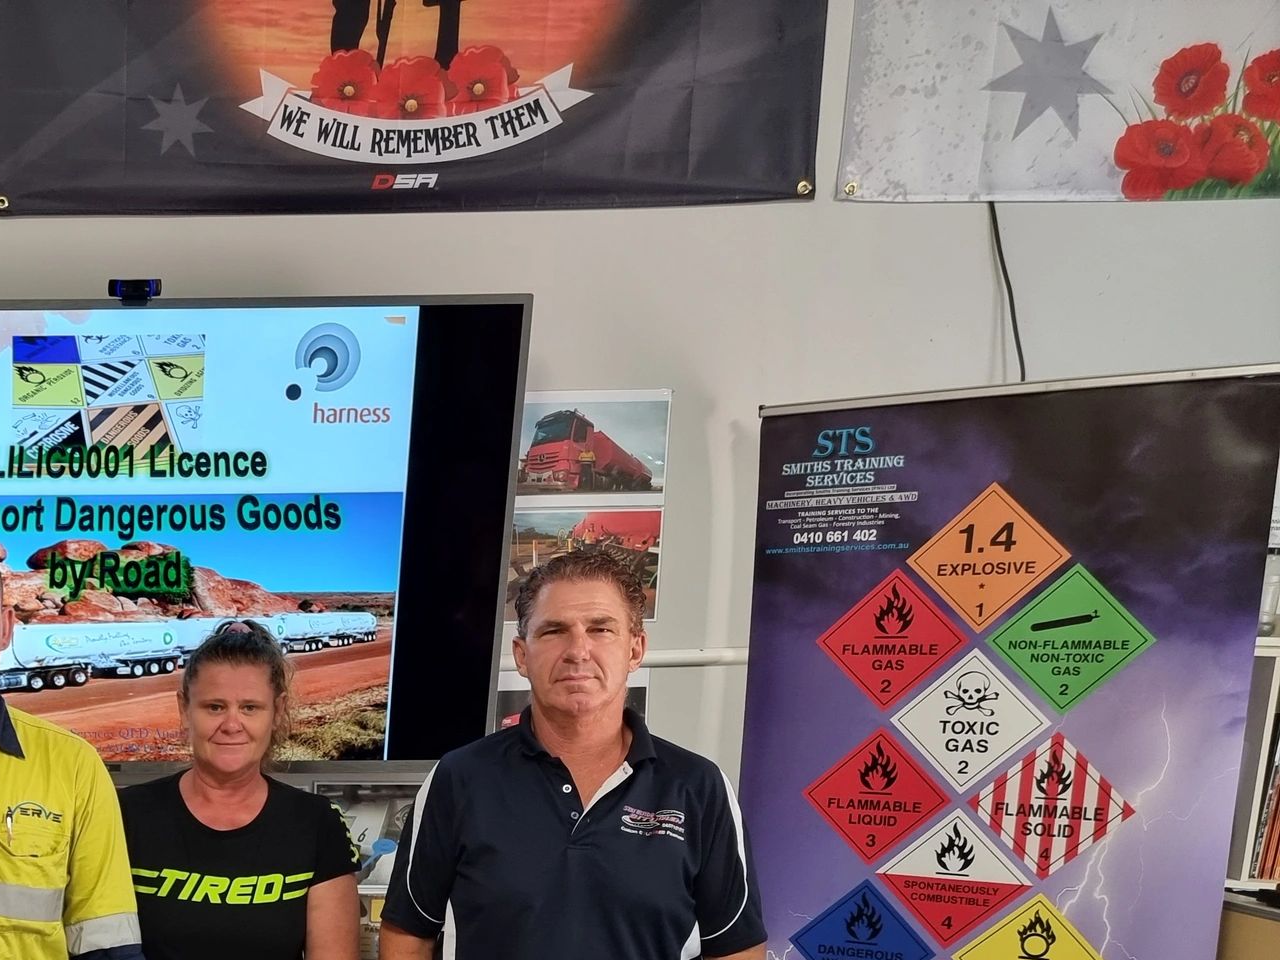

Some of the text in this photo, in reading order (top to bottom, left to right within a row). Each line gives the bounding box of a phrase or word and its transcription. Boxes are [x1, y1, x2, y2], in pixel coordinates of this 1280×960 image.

[280, 97, 549, 157] WE WILL REMEMBER THEM
[371, 173, 439, 190] DSA
[312, 403, 391, 424] harness
[101, 410, 138, 445] DANGEROUS
[813, 427, 873, 457] STS
[150, 445, 267, 479] Licence
[782, 456, 904, 475] SMITHS TRAINING
[806, 472, 874, 487] SERVICES
[55, 497, 226, 540] Dangerous
[237, 494, 341, 531] Goods
[793, 530, 876, 543] 0410 661 402
[958, 522, 1016, 554] 1.4
[766, 542, 909, 554] www.smithstrainingservices.com.au
[48, 552, 184, 598] by Road
[937, 561, 1036, 576] EXPLOSIVE
[842, 644, 938, 655] FLAMMABLE
[1008, 639, 1130, 651] NON-FLAMMABLE
[872, 659, 904, 671] GAS
[1030, 653, 1104, 663] NON-TOXIC
[1051, 666, 1081, 676] GAS
[940, 720, 999, 735] TOXIC
[945, 738, 989, 753] GAS
[827, 798, 922, 813] FLAMMABLE
[994, 802, 1104, 821] FLAMMABLE
[848, 813, 897, 827] LIQUID
[1021, 823, 1074, 838] SOLID
[903, 880, 999, 896] SPONTANEOUSLY
[910, 893, 990, 908] COMBUSTIBLE
